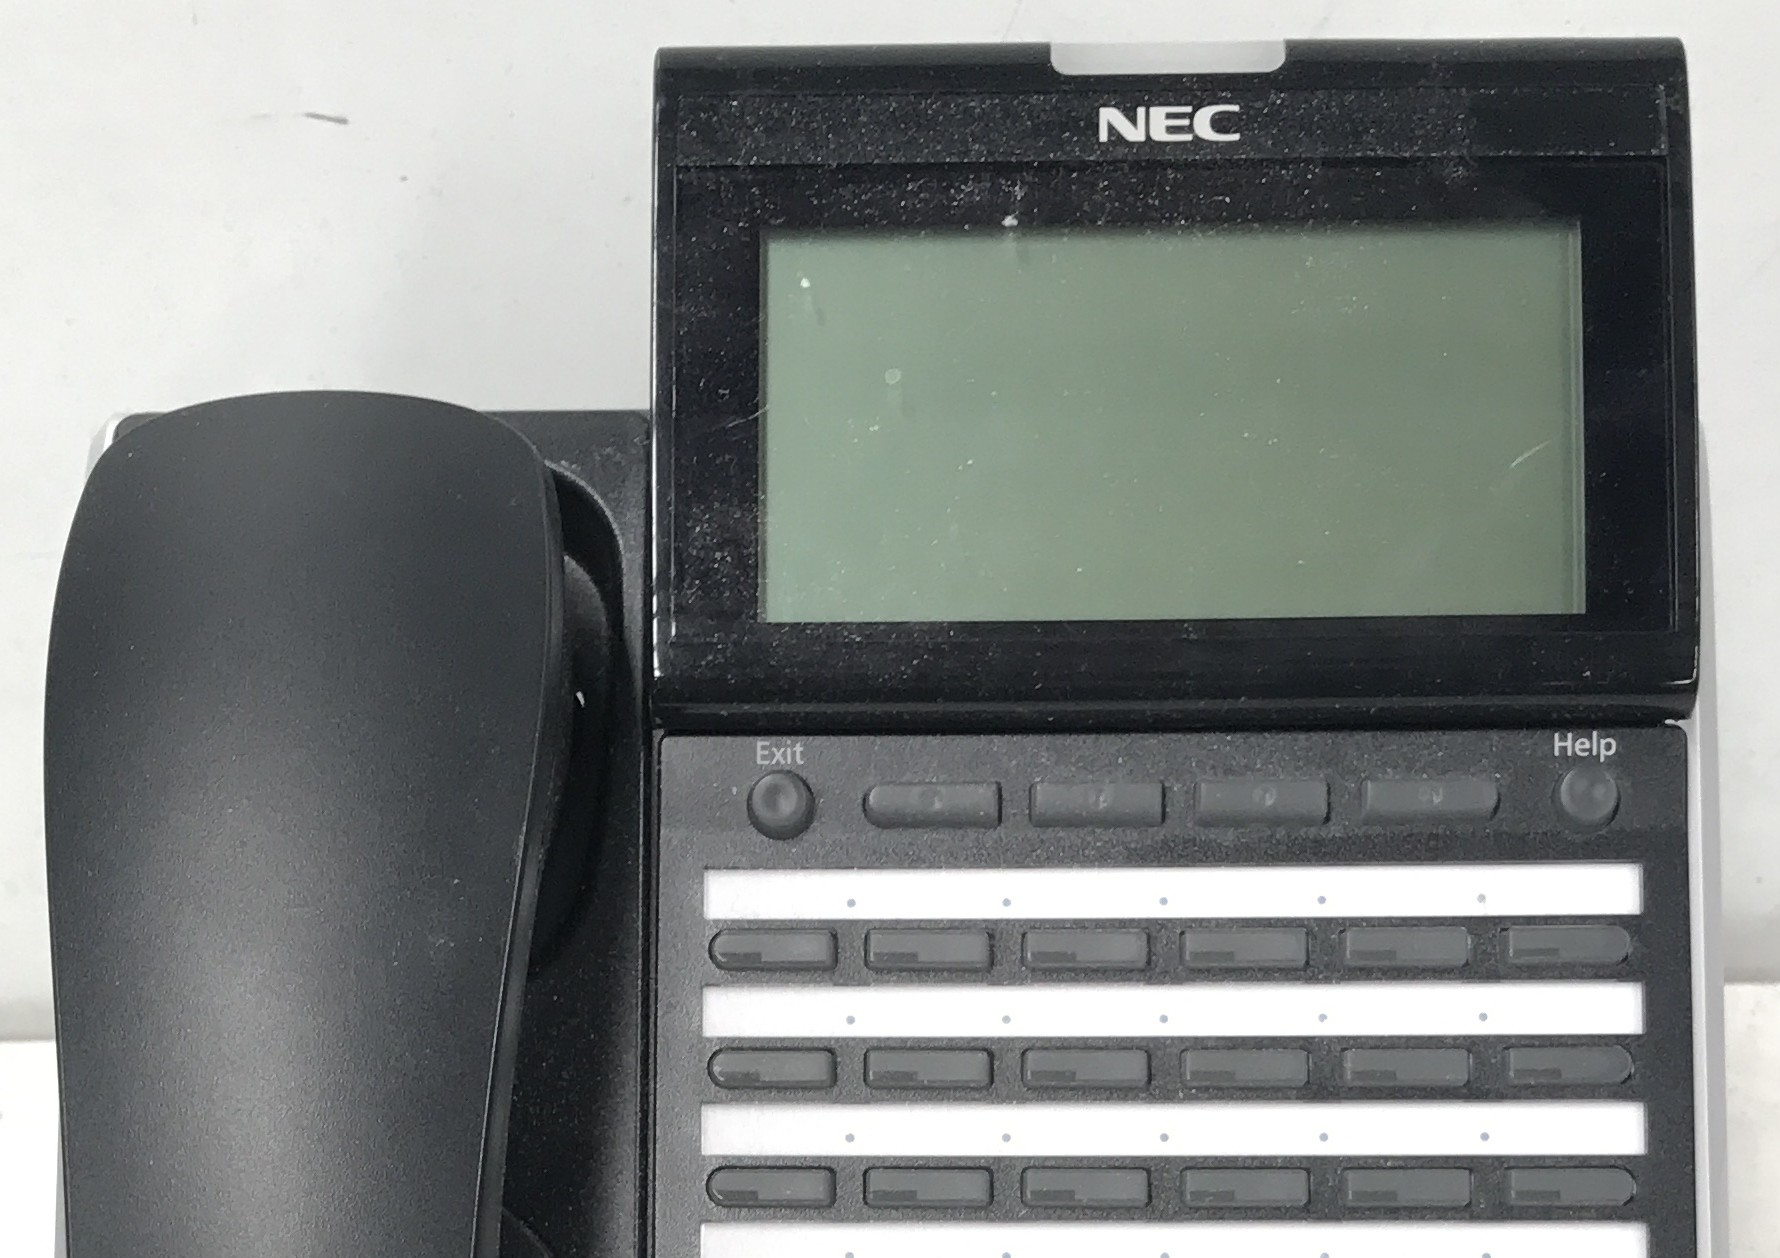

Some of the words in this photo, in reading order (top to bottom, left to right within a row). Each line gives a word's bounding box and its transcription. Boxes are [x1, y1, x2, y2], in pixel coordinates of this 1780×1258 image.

[1098, 104, 1241, 143] NEC
[756, 739, 805, 766] Exit
[1553, 730, 1617, 763] Help
